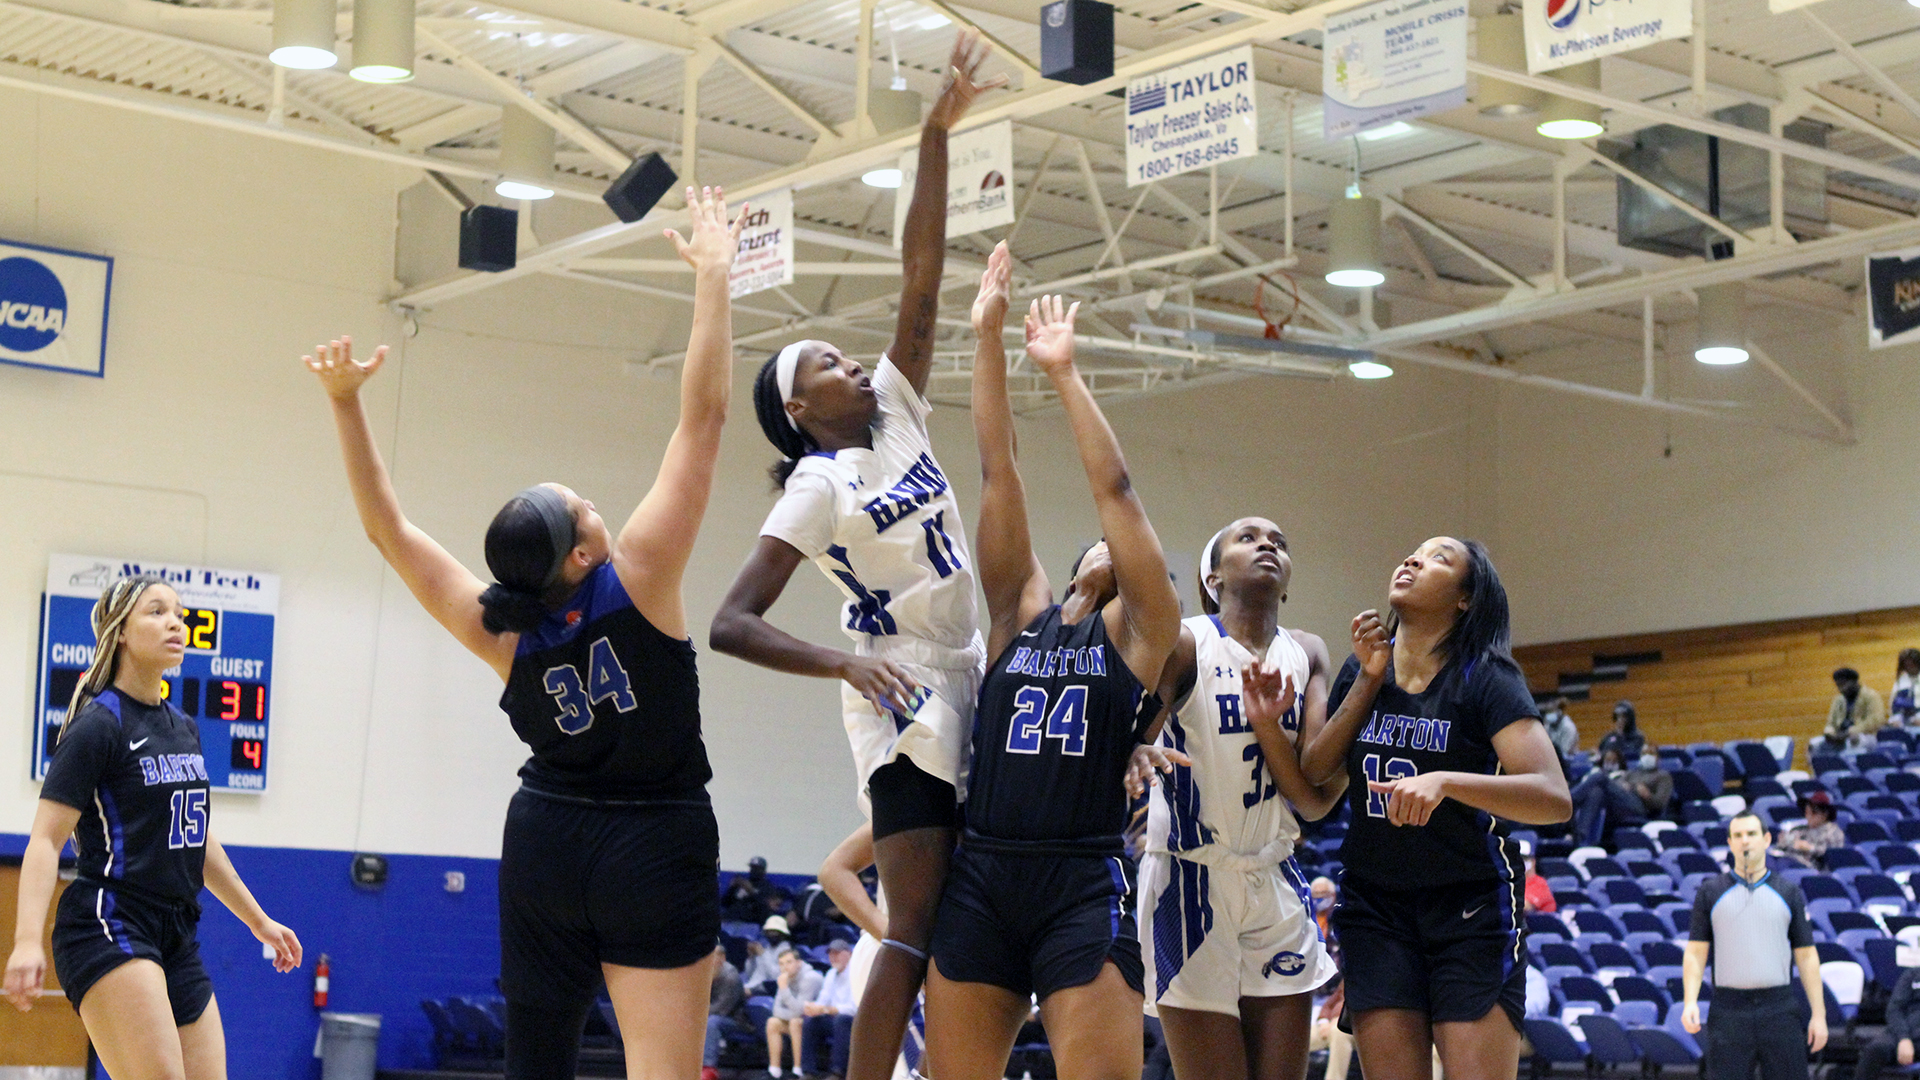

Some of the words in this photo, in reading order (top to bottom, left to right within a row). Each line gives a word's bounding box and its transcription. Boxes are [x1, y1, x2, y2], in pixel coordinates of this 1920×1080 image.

[1549, 34, 1609, 58] McPherson
[1613, 19, 1662, 43] Beverage
[1171, 62, 1248, 102] TAYLOR
[1128, 120, 1159, 148] Taylor
[1163, 110, 1201, 135] Freezer
[1204, 99, 1232, 123] Sales
[921, 510, 962, 579] 11
[199, 570, 260, 590] Tech
[211, 658, 263, 678] GUEST
[1006, 644, 1106, 677] BARTON
[221, 681, 264, 720] 31
[543, 636, 638, 735] 34
[230, 724, 265, 738] FOULS
[1005, 685, 1088, 756] 24
[1357, 710, 1451, 753] ARTON
[140, 754, 209, 785] BARTO
[243, 741, 260, 768] 4
[228, 774, 263, 788] SCORE
[169, 788, 207, 850] 15
